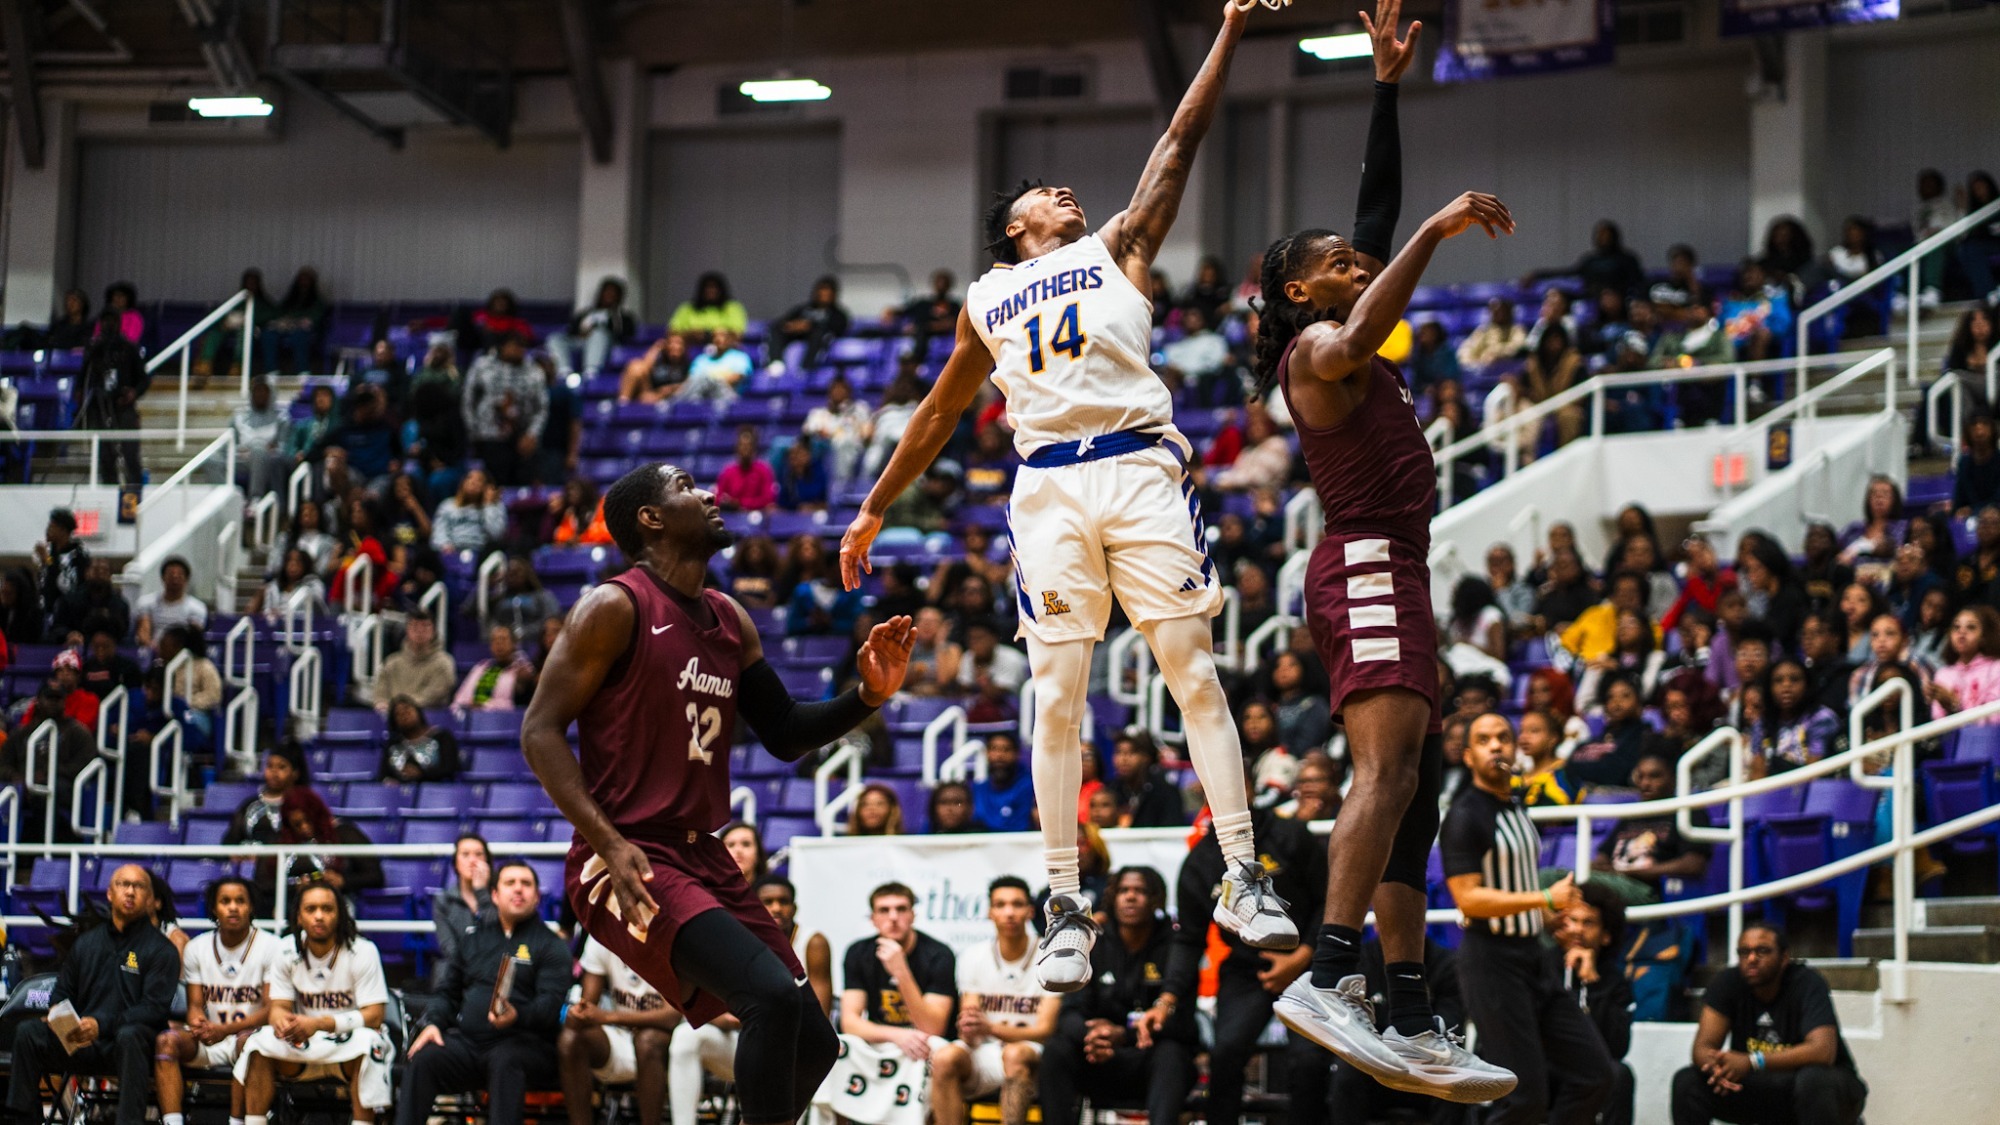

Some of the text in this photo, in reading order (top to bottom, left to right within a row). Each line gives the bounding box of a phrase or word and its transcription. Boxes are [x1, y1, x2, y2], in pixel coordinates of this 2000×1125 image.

[986, 266, 1103, 334] PANTHERS
[1023, 301, 1088, 375] 14
[677, 657, 733, 698] Aamu
